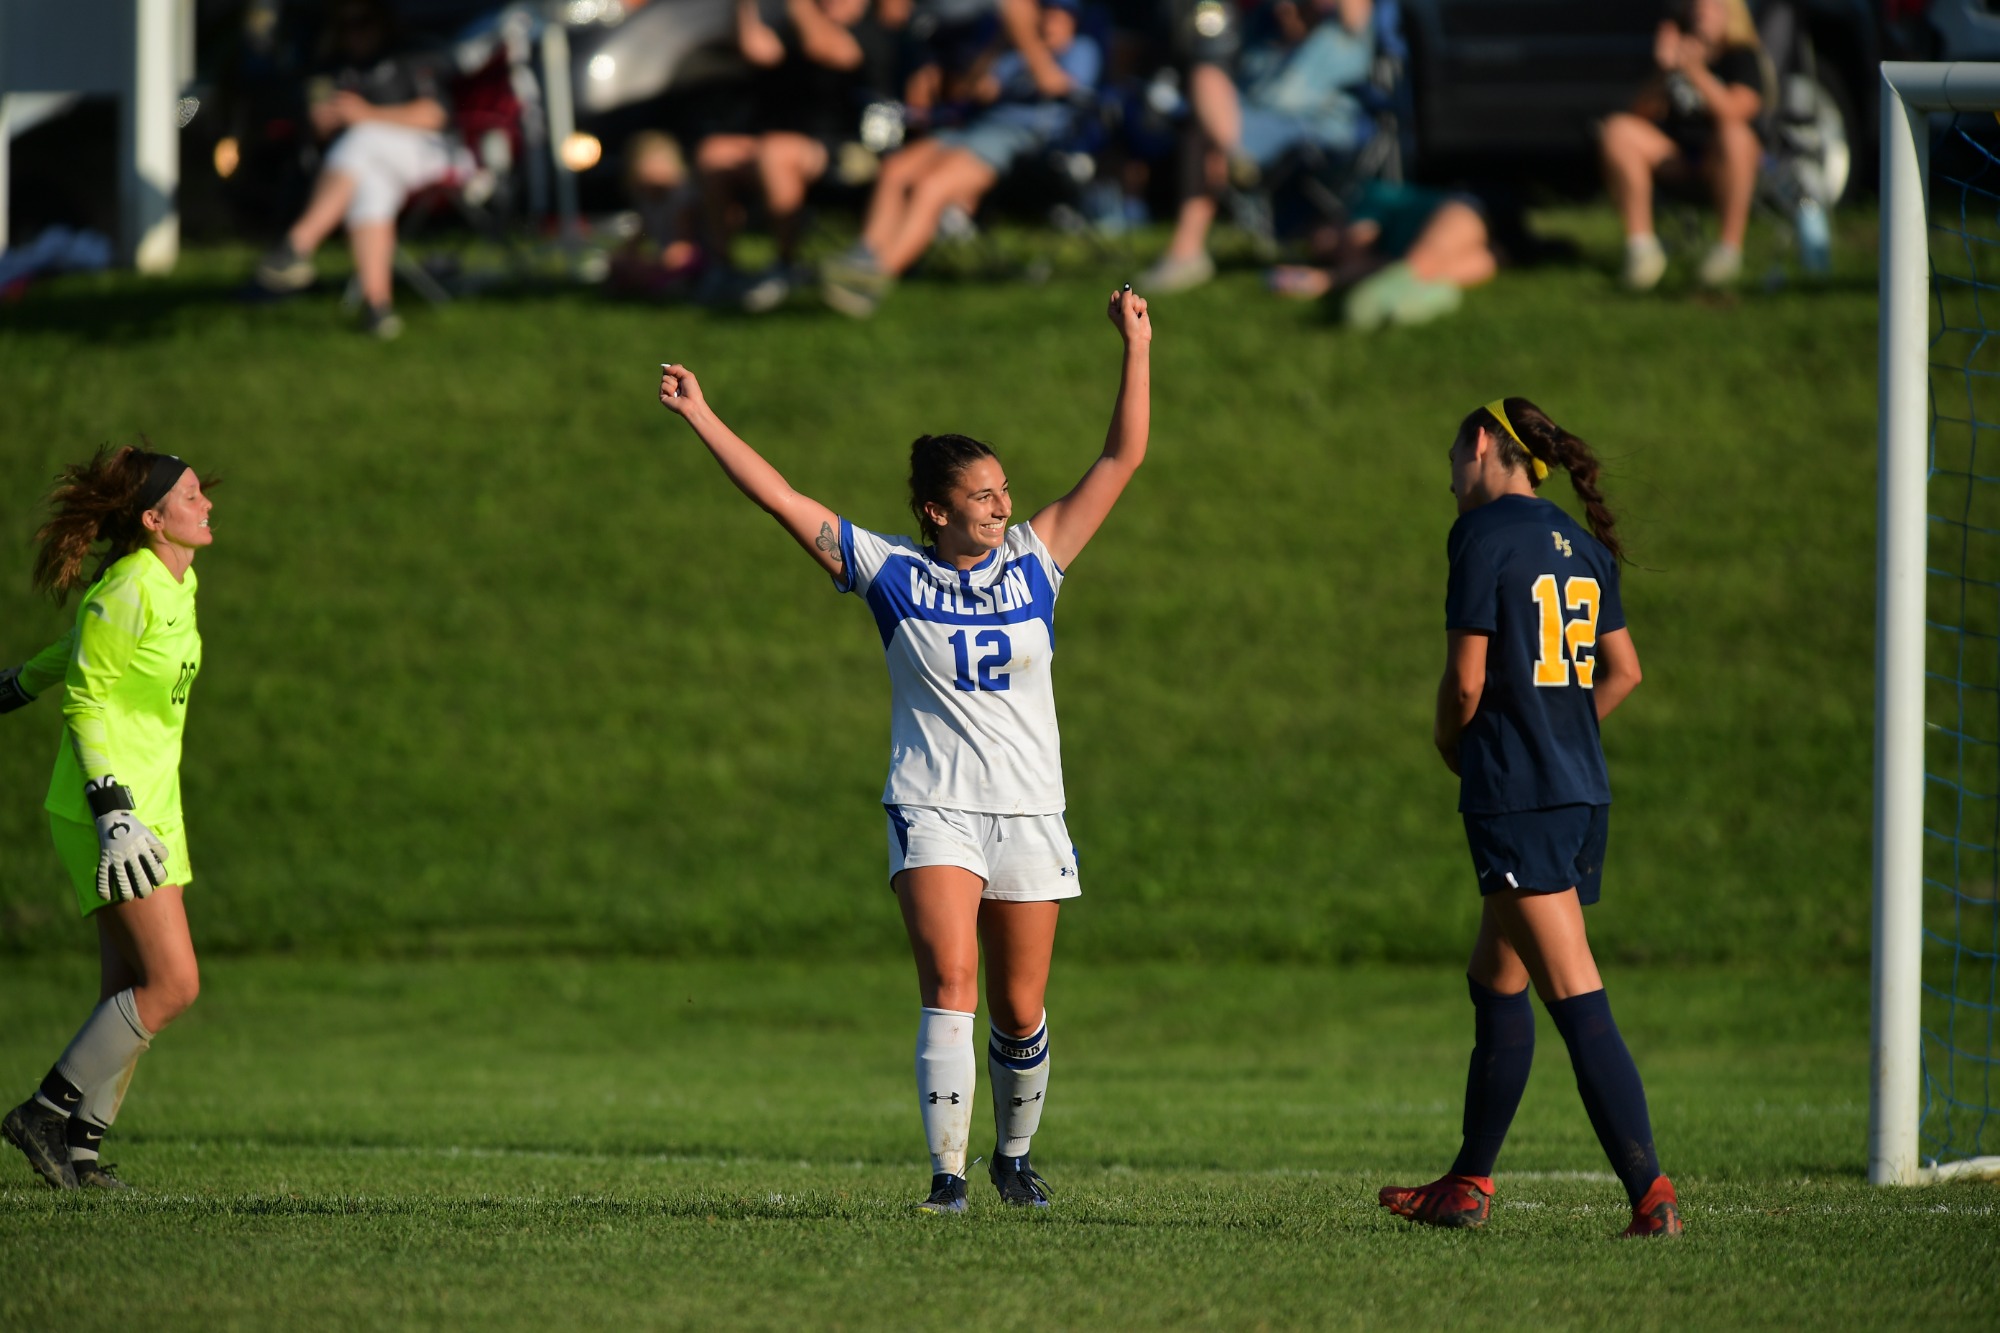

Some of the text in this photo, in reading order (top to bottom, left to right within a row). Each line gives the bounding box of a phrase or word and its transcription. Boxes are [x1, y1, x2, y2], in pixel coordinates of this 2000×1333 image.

[911, 566, 1033, 615] WILSON
[1531, 574, 1601, 689] 12
[171, 661, 196, 704] 00
[948, 629, 1012, 691] 12
